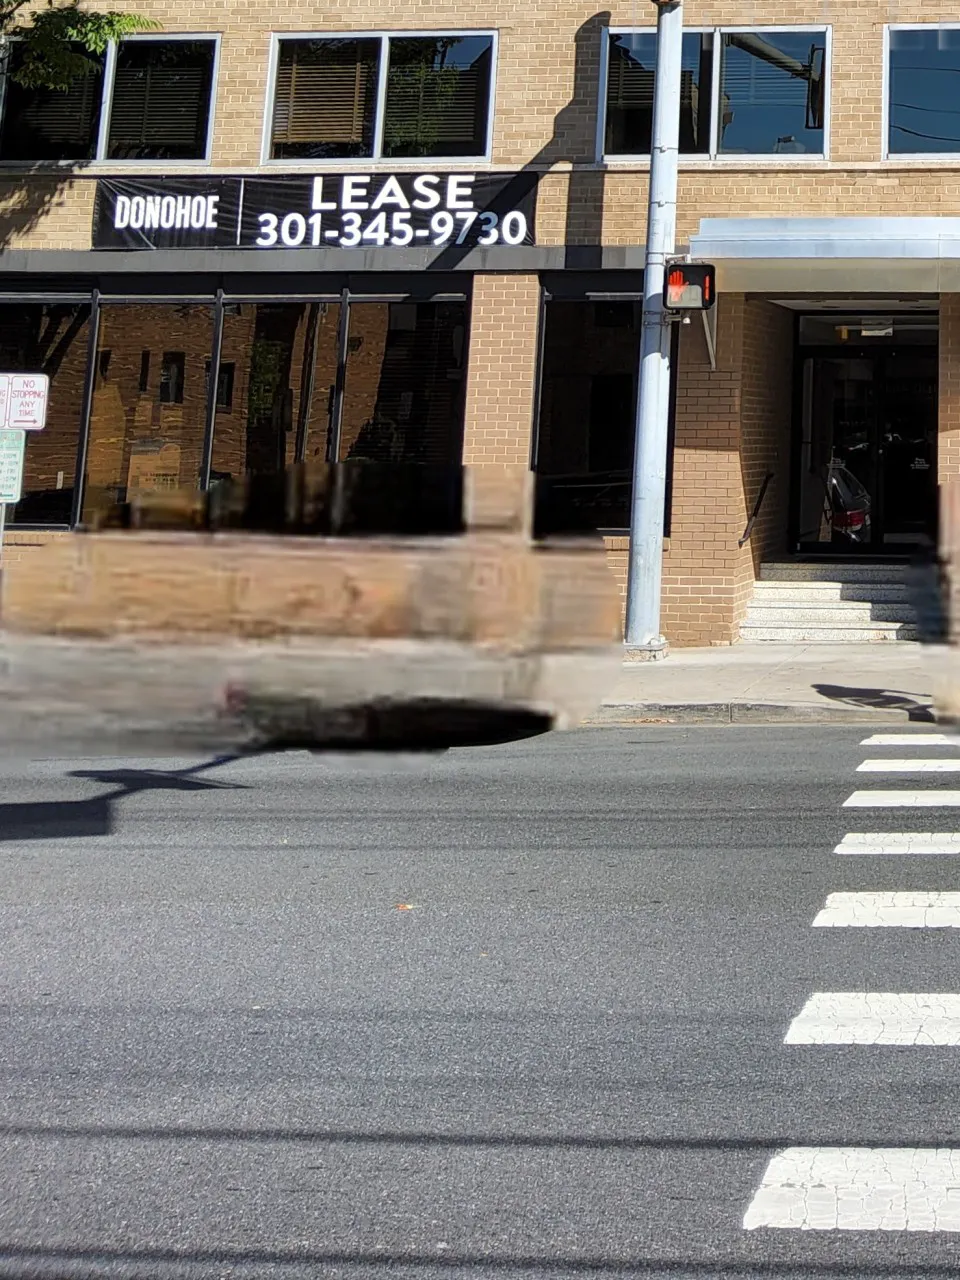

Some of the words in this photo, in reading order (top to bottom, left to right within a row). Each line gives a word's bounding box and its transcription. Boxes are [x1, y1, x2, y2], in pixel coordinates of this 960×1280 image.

[311, 175, 476, 210] LEASE
[114, 195, 220, 229] DONOHOE
[255, 211, 528, 247] 301-345-9730
[22, 379, 36, 389] NO
[11, 389, 45, 399] STOPPING
[19, 400, 36, 408] ANY
[18, 409, 35, 417] TIME
